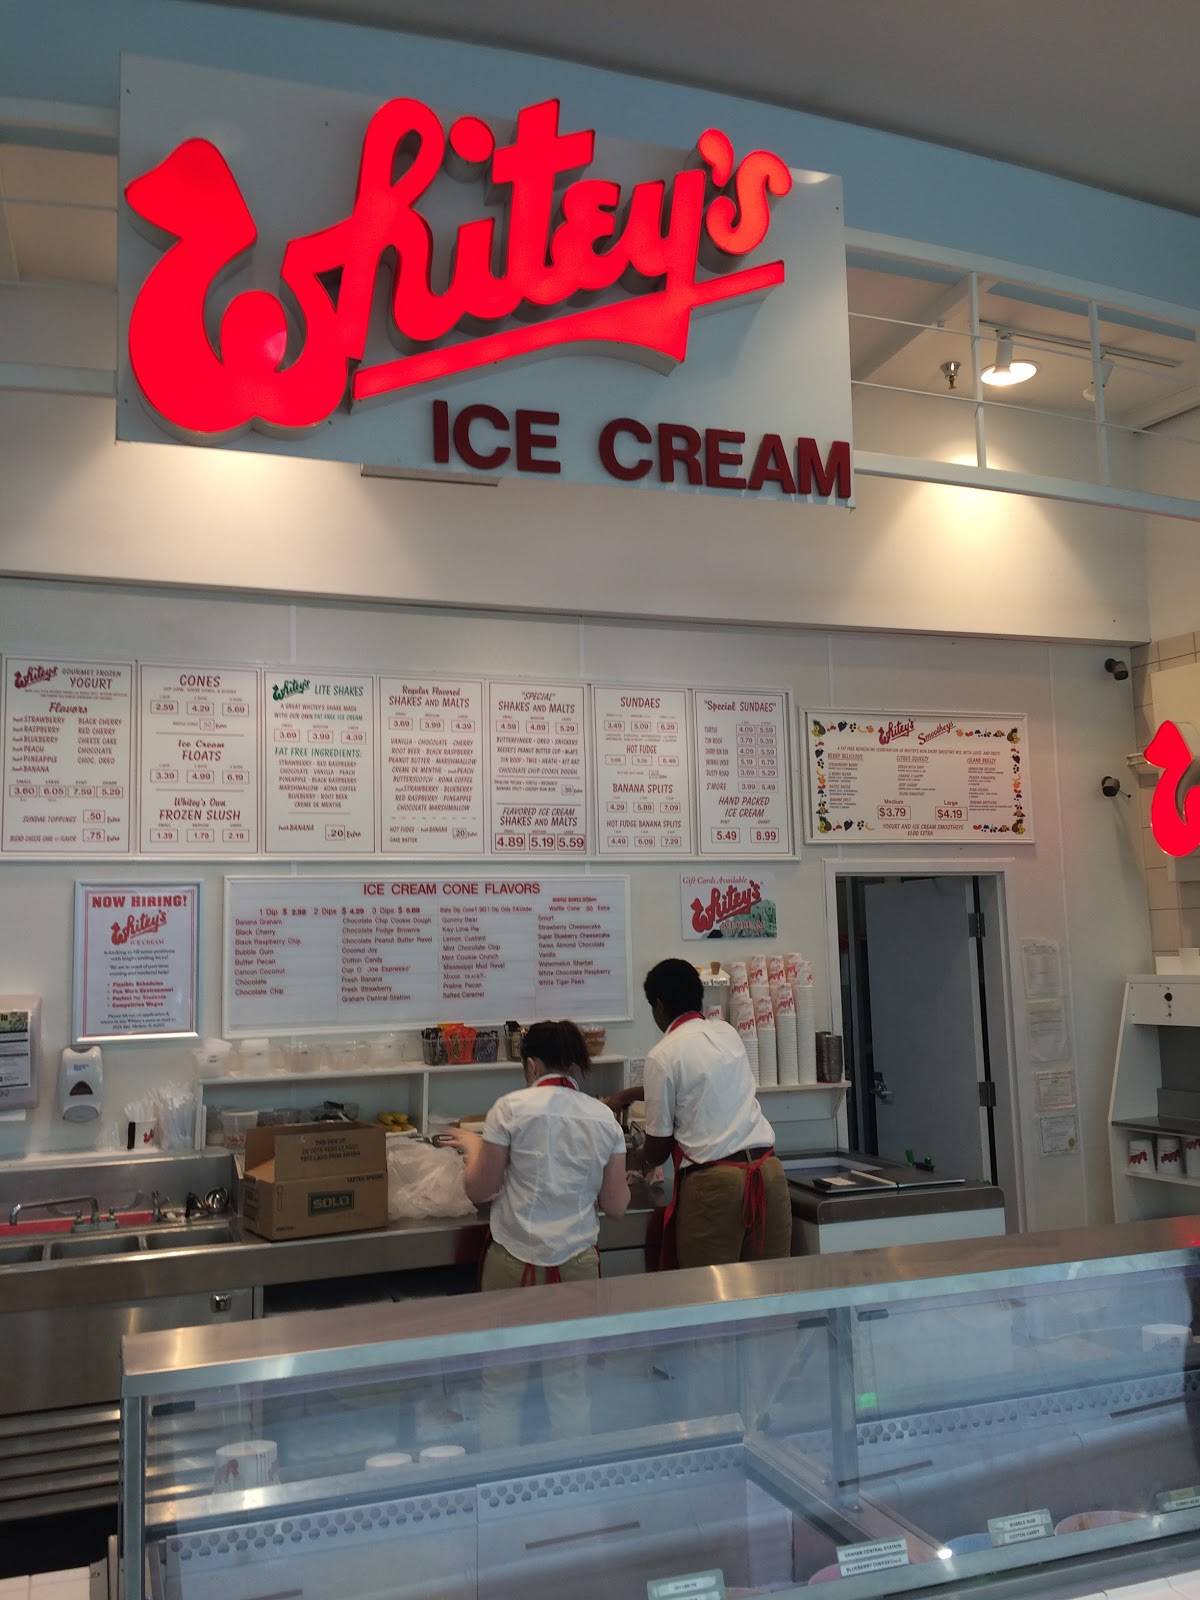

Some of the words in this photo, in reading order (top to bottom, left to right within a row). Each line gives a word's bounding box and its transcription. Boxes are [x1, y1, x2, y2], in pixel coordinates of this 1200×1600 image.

[124, 98, 792, 433] Whitey's
[433, 399, 561, 474] ICE
[600, 418, 851, 499] CREAM
[70, 677, 113, 689] YOGURT
[179, 674, 221, 687] CONES
[314, 684, 331, 696] LITE
[333, 685, 364, 697] SHAKES
[402, 685, 429, 696] Regular
[432, 686, 460, 696] Flavored
[389, 695, 422, 706] SHAKES
[425, 699, 439, 707] AND
[442, 698, 470, 708] MALTS
[498, 700, 530, 712] SHAKES
[532, 704, 546, 712] AND
[549, 703, 575, 714] MALTS
[620, 696, 661, 708] SUNDAES
[49, 702, 88, 713] Flavors
[178, 739, 191, 748] Ice
[196, 740, 225, 748] Cream
[275, 747, 288, 755] FAT
[626, 745, 638, 754] HOT
[640, 745, 657, 754] FUDGE
[182, 750, 222, 761] FLOATS
[612, 783, 645, 793] BANANA
[647, 784, 673, 793] SPLITS
[718, 796, 740, 806] HAND
[742, 796, 770, 806] PACKED
[159, 809, 202, 821] FROZEN
[206, 810, 241, 821] SLUSH
[502, 807, 537, 816] FLAVORED
[538, 807, 551, 816] ICE
[551, 808, 575, 816] CREAM
[725, 808, 738, 817] ICE
[739, 808, 765, 818] CREAM
[879, 807, 906, 818] $3.79
[937, 809, 962, 819] $4.19
[500, 816, 532, 826] SHAKES
[551, 817, 578, 827] MALTS
[619, 820, 637, 828] FUDGE
[638, 820, 661, 828] BANANA
[662, 820, 681, 828] SPLITS
[717, 830, 737, 841] 5.49
[756, 831, 776, 841] 8.99
[497, 836, 523, 848] 4.89
[531, 837, 554, 848] 5.19
[558, 837, 584, 848] 5.59
[363, 882, 384, 895] ICE
[391, 882, 437, 895] CREAM
[442, 882, 478, 895] CONE
[484, 882, 541, 895] FLAVORS
[92, 896, 126, 907] NOW
[131, 895, 187, 907] HIRING!
[690, 880, 762, 933] Whitey's
[321, 908, 337, 916] Dips
[111, 909, 167, 945] Whitey's
[256, 928, 276, 936] Cherry
[270, 987, 284, 995] Chip
[313, 1195, 350, 1209] SOLO
